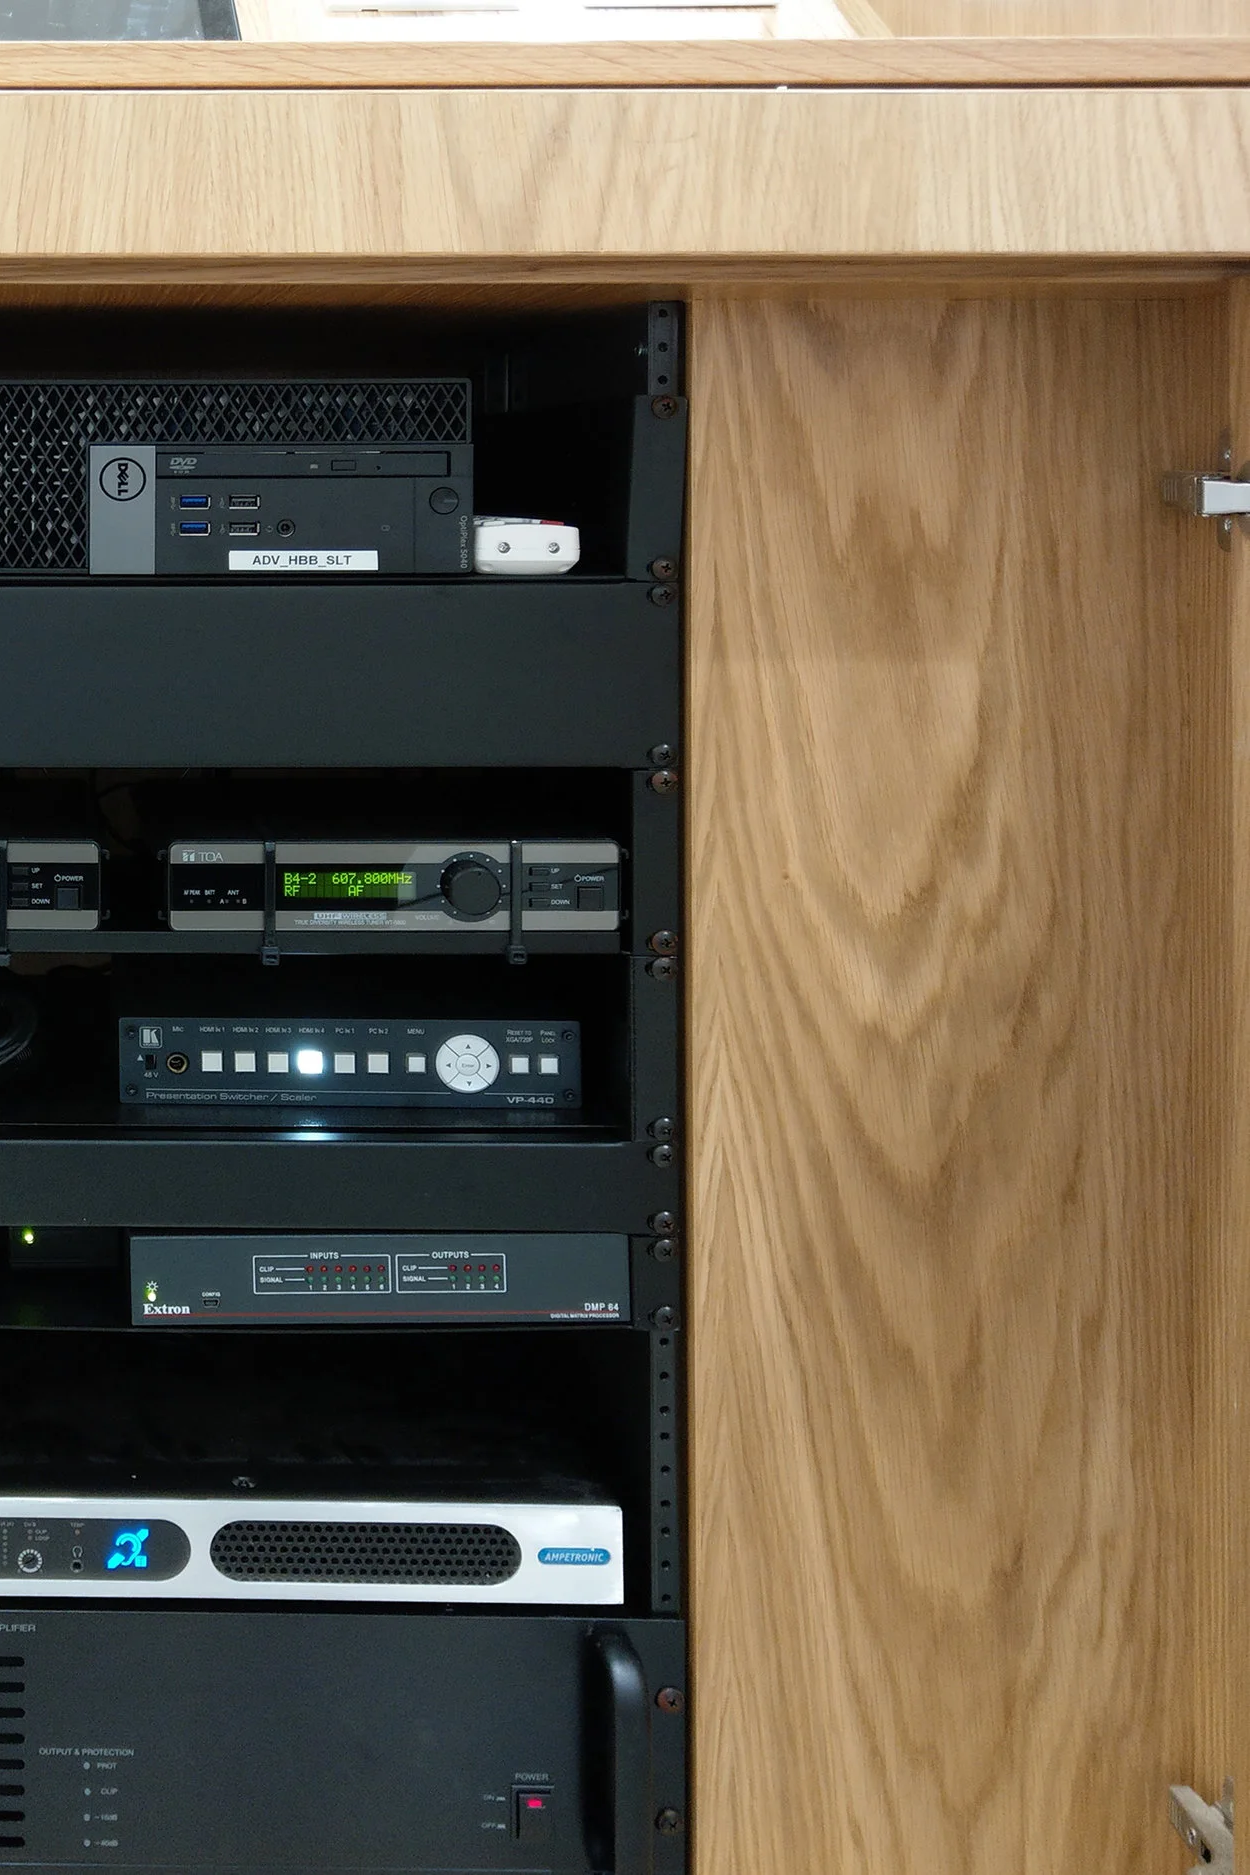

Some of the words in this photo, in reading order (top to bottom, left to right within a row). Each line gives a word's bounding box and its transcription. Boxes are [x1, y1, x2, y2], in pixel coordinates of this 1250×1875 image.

[170, 457, 197, 466] DVD
[117, 463, 129, 496] DELL
[460, 515, 468, 547] OptiPlex
[252, 555, 353, 568] ADV_HBB_SLT
[460, 549, 468, 569] 5040
[199, 852, 224, 862] TOA
[284, 873, 317, 885] B4-2
[332, 873, 413, 885] 607.800MHz
[284, 886, 301, 897] RF
[348, 885, 364, 897] AF
[146, 1091, 217, 1101] Presentation
[220, 1092, 269, 1101] Switcher
[281, 1093, 317, 1101] Scaler
[507, 1097, 555, 1105] VP-440
[310, 1252, 340, 1260] INPUTS
[432, 1251, 470, 1259] OUTPUTS
[143, 1304, 191, 1315] Extron
[584, 1303, 606, 1312] DMP
[608, 1303, 619, 1311] 64
[545, 1553, 604, 1562] AMPETRONIC
[82, 1748, 135, 1756] PROTECTION
[515, 1773, 549, 1781] POWER
